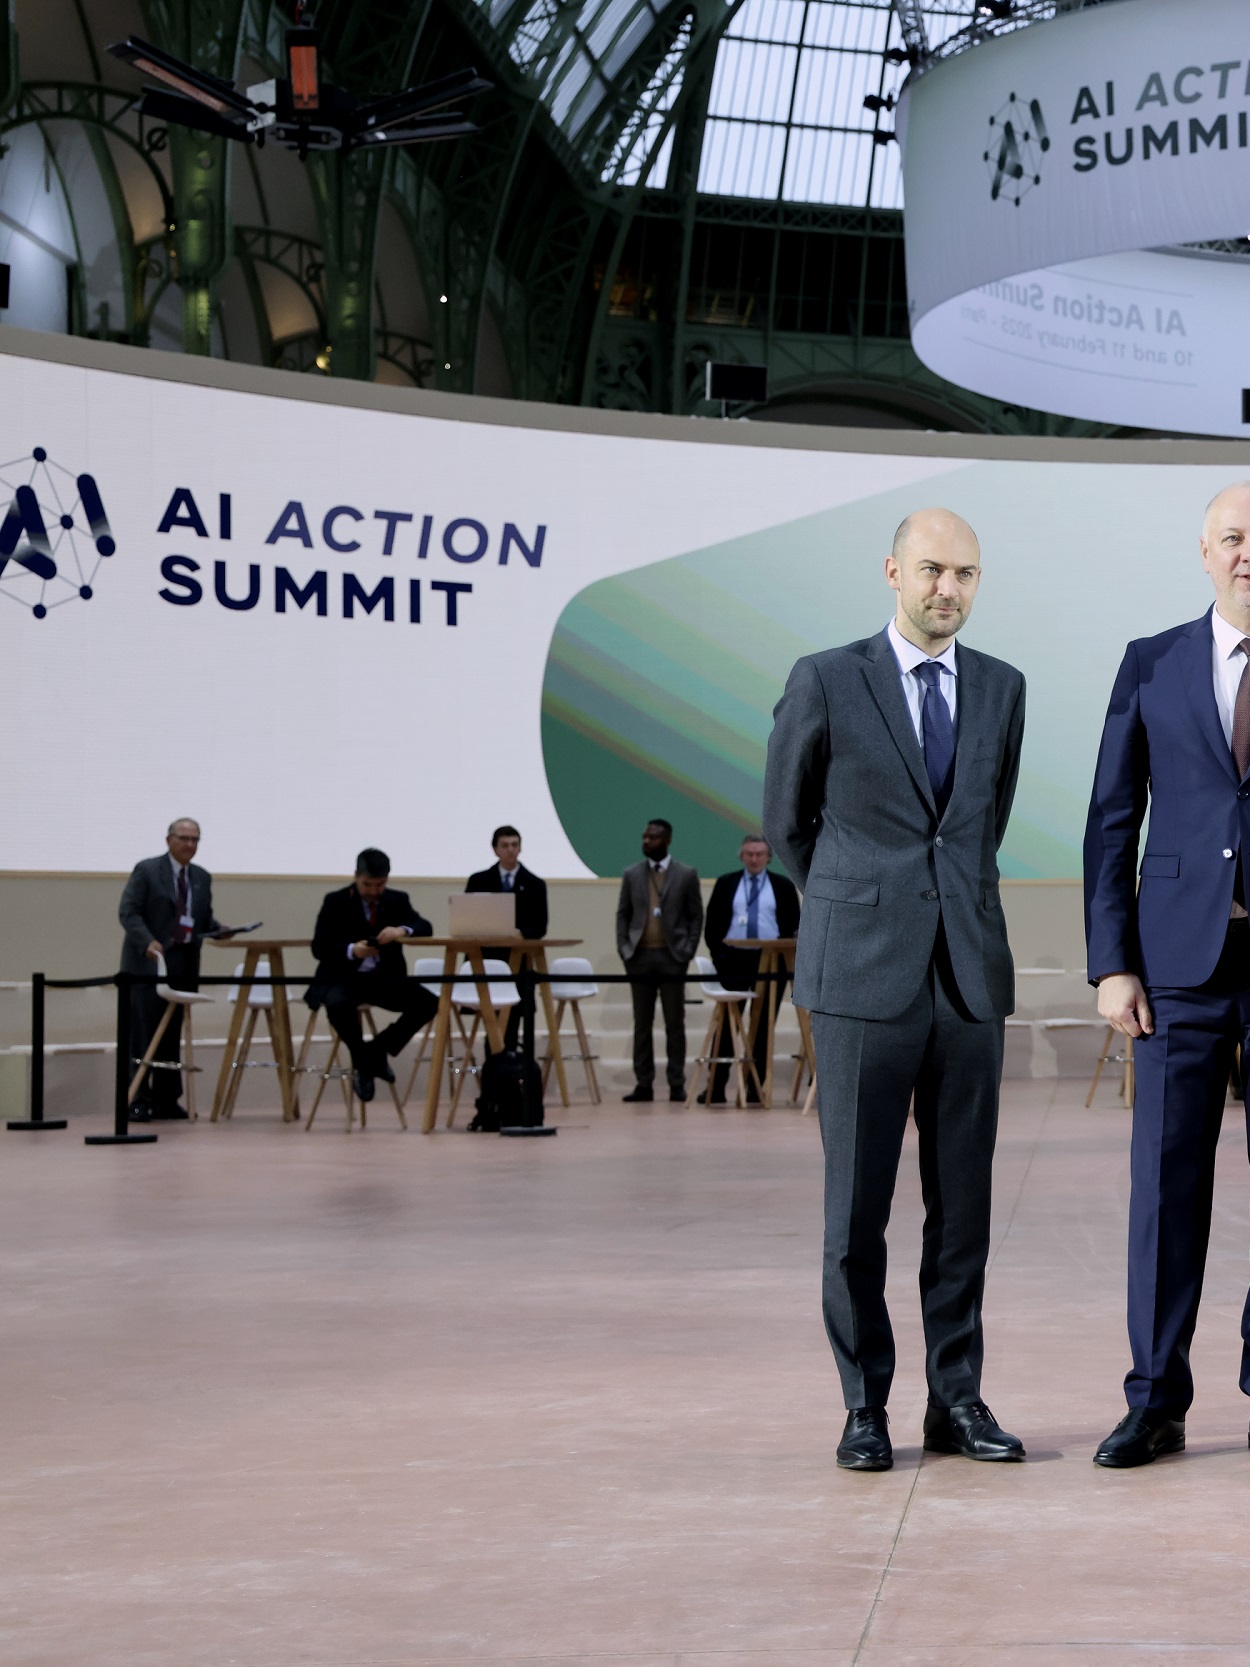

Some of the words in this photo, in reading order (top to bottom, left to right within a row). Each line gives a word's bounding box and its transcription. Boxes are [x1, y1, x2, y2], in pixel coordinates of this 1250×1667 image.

[1070, 81, 1114, 125] AI
[156, 487, 233, 541] AI
[264, 499, 548, 568] ACTION
[157, 554, 473, 627] SUMMIT
